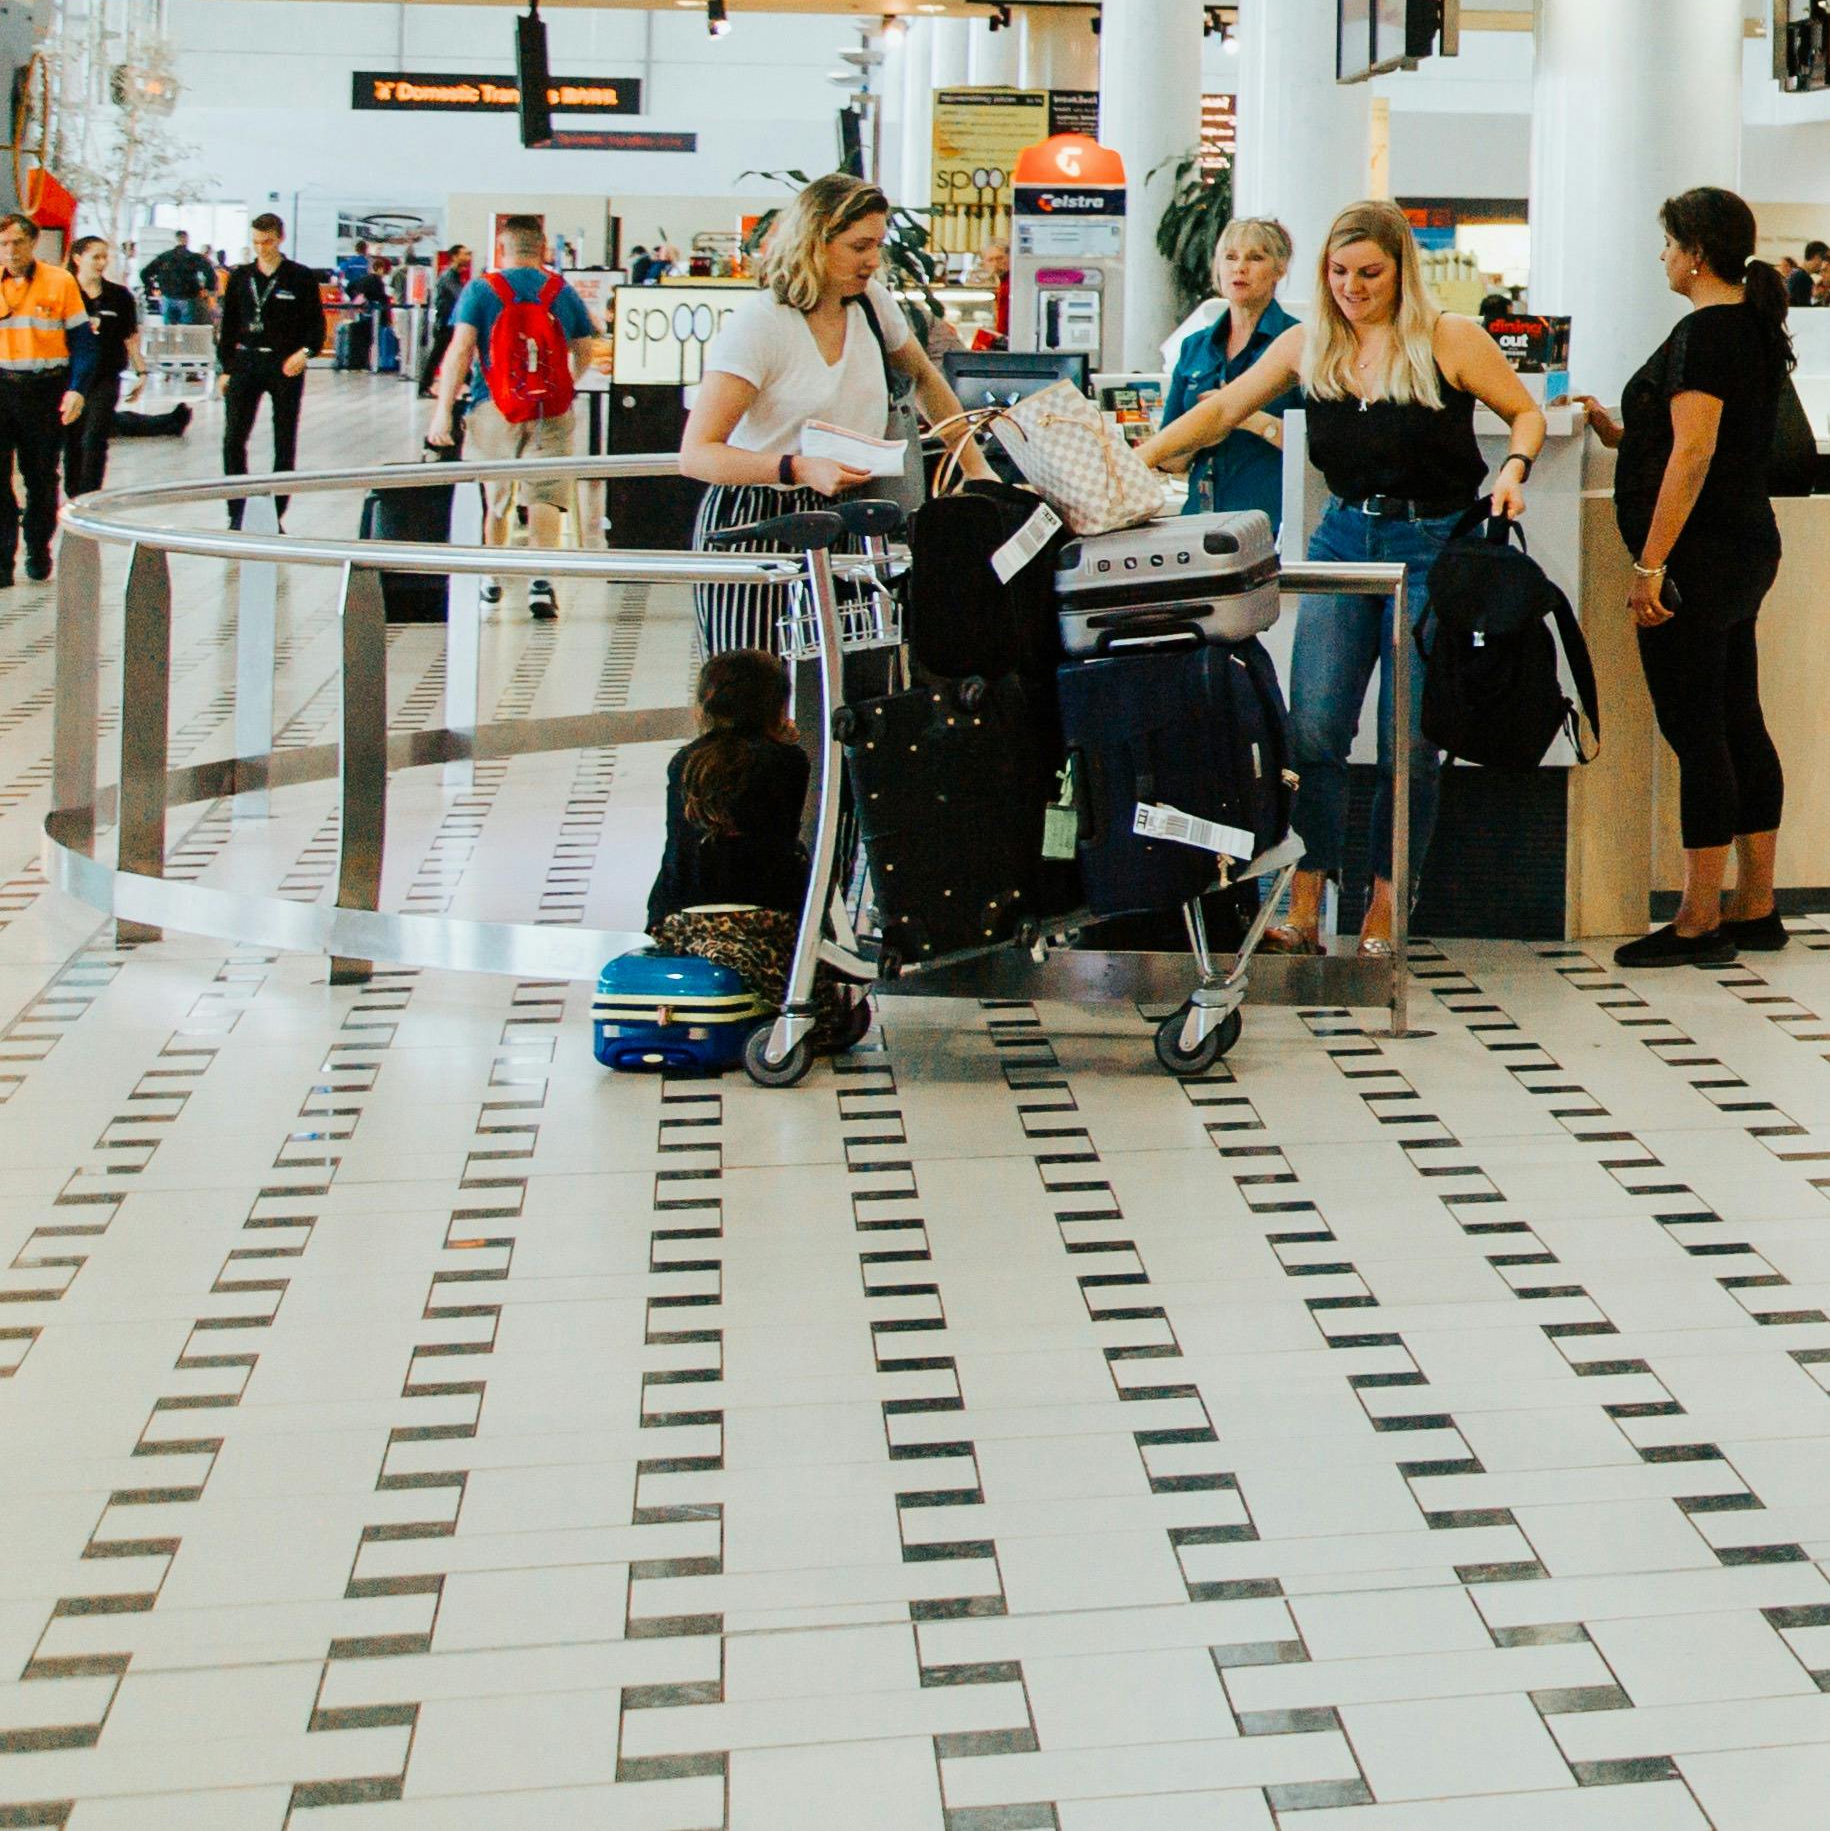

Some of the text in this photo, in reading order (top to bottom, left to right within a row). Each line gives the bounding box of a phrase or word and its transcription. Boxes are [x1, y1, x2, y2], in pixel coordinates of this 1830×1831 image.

[1036, 193, 1105, 212] Telstra
[1488, 319, 1543, 335] dining
[1499, 334, 1529, 348] out
